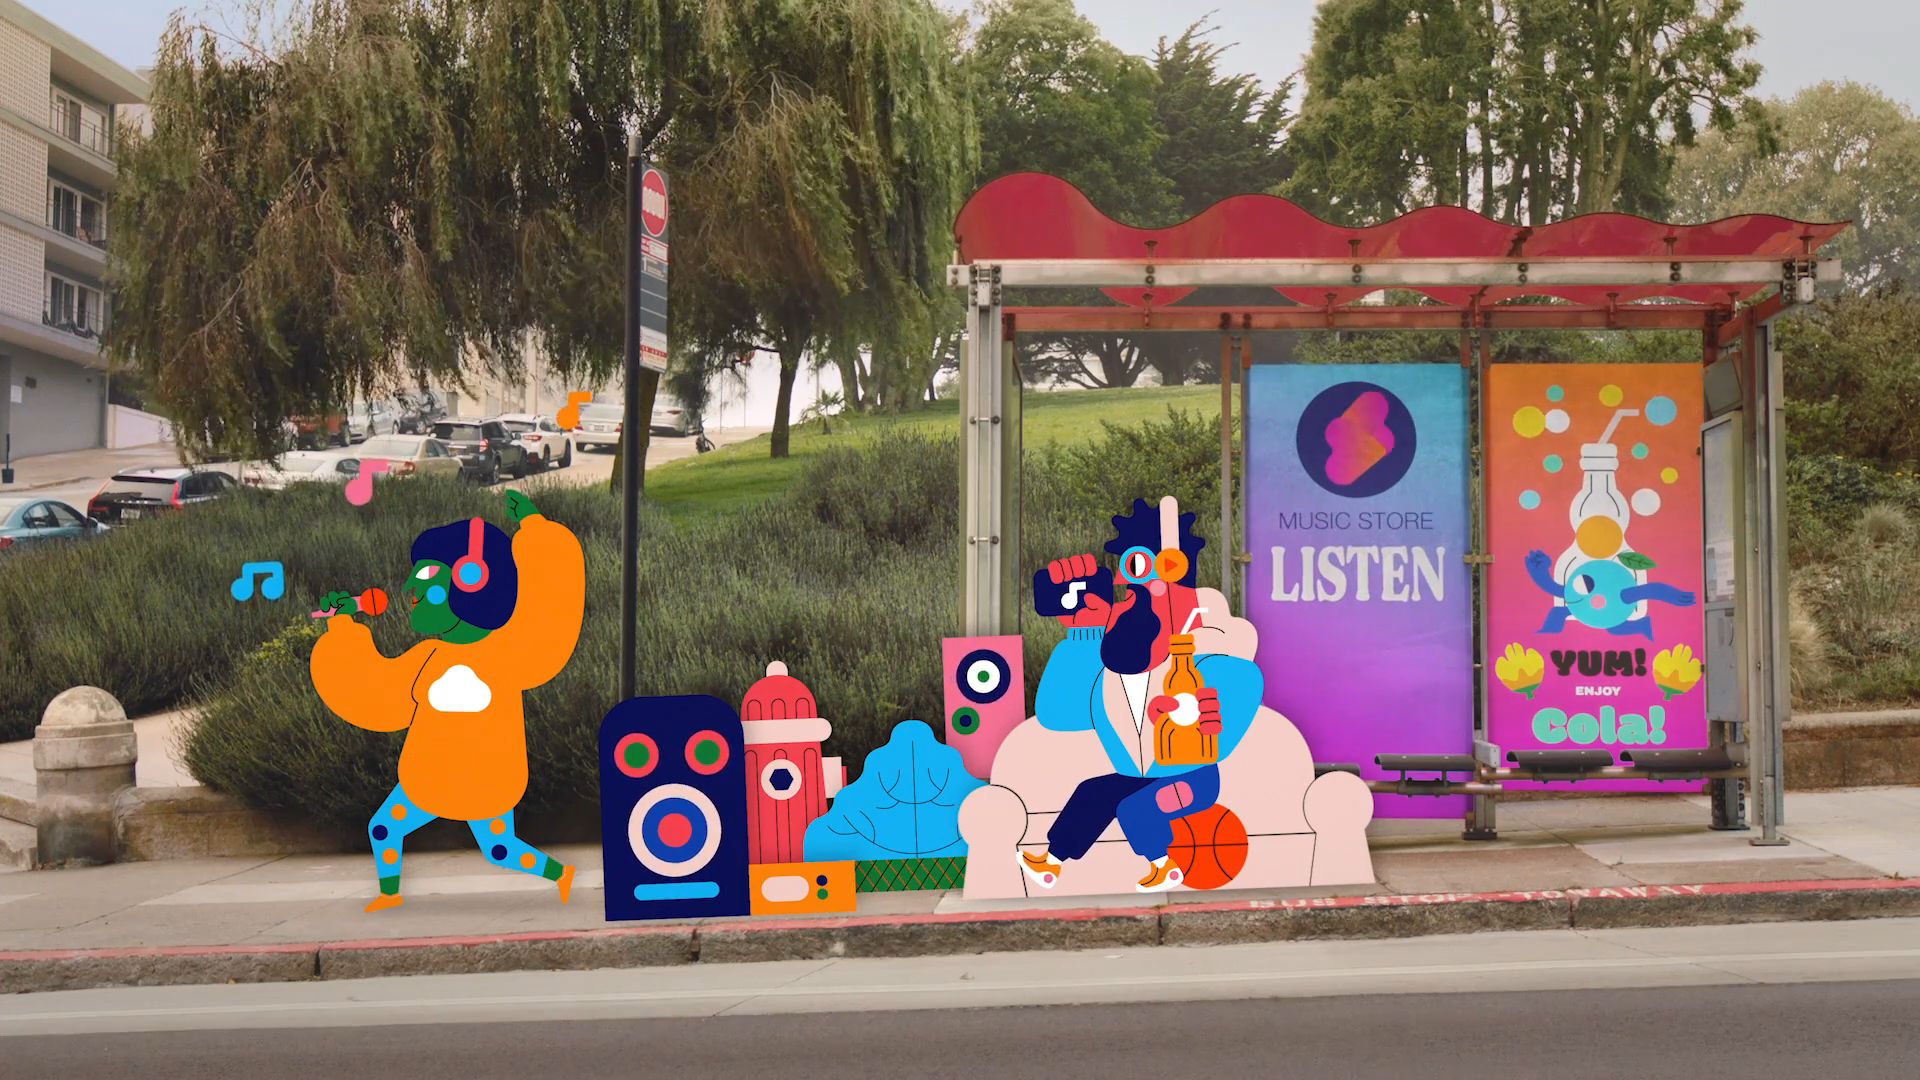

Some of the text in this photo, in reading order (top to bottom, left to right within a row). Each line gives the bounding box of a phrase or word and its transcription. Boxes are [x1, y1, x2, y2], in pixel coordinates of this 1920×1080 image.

[1279, 511, 1434, 530] MUSIC STORE
[1270, 545, 1446, 602] LISTEN
[1550, 647, 1647, 677] YUM!
[1575, 686, 1621, 696] ENJOY
[1531, 704, 1667, 745] Cola!
[1249, 897, 1337, 909] BUS
[1363, 893, 1472, 906] STOP
